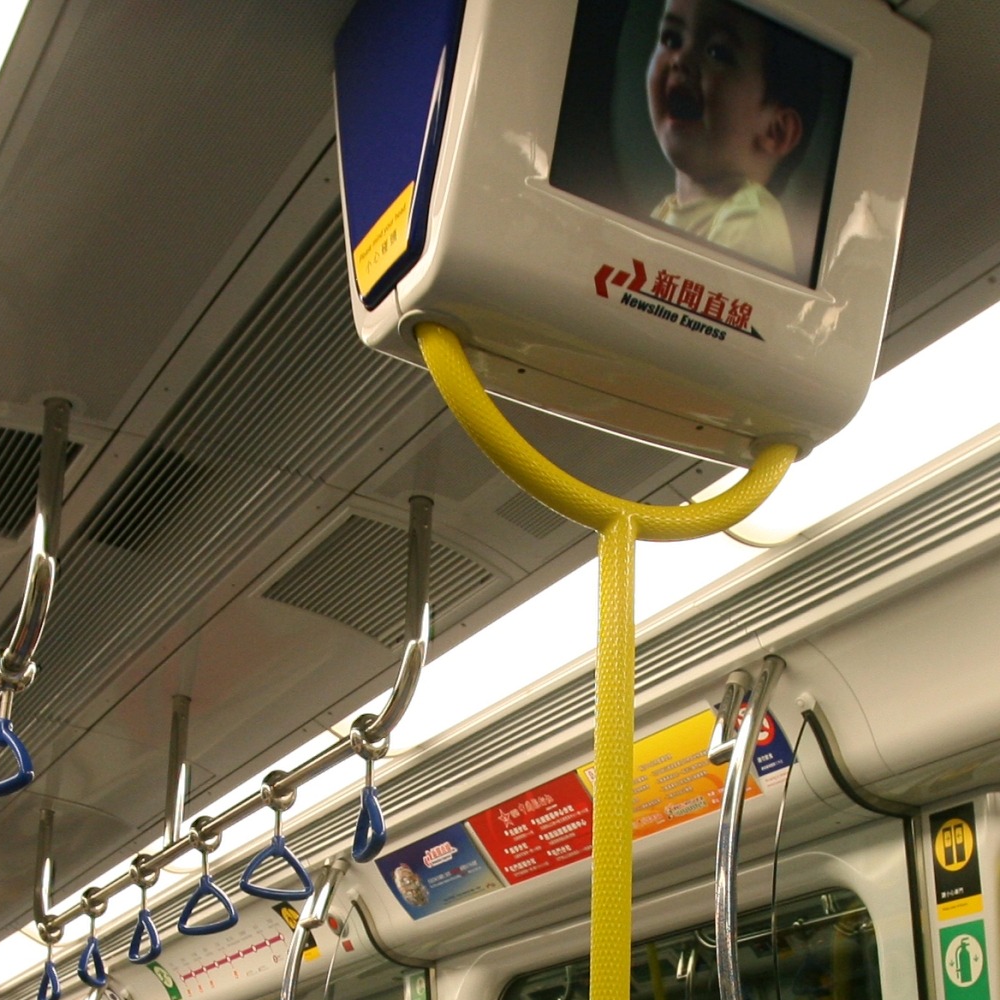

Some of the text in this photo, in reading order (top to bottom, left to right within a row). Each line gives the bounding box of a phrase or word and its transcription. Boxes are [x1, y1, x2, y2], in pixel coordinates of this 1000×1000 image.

[620, 292, 727, 341] Newsline Express
[651, 269, 753, 329] 新聞直線
